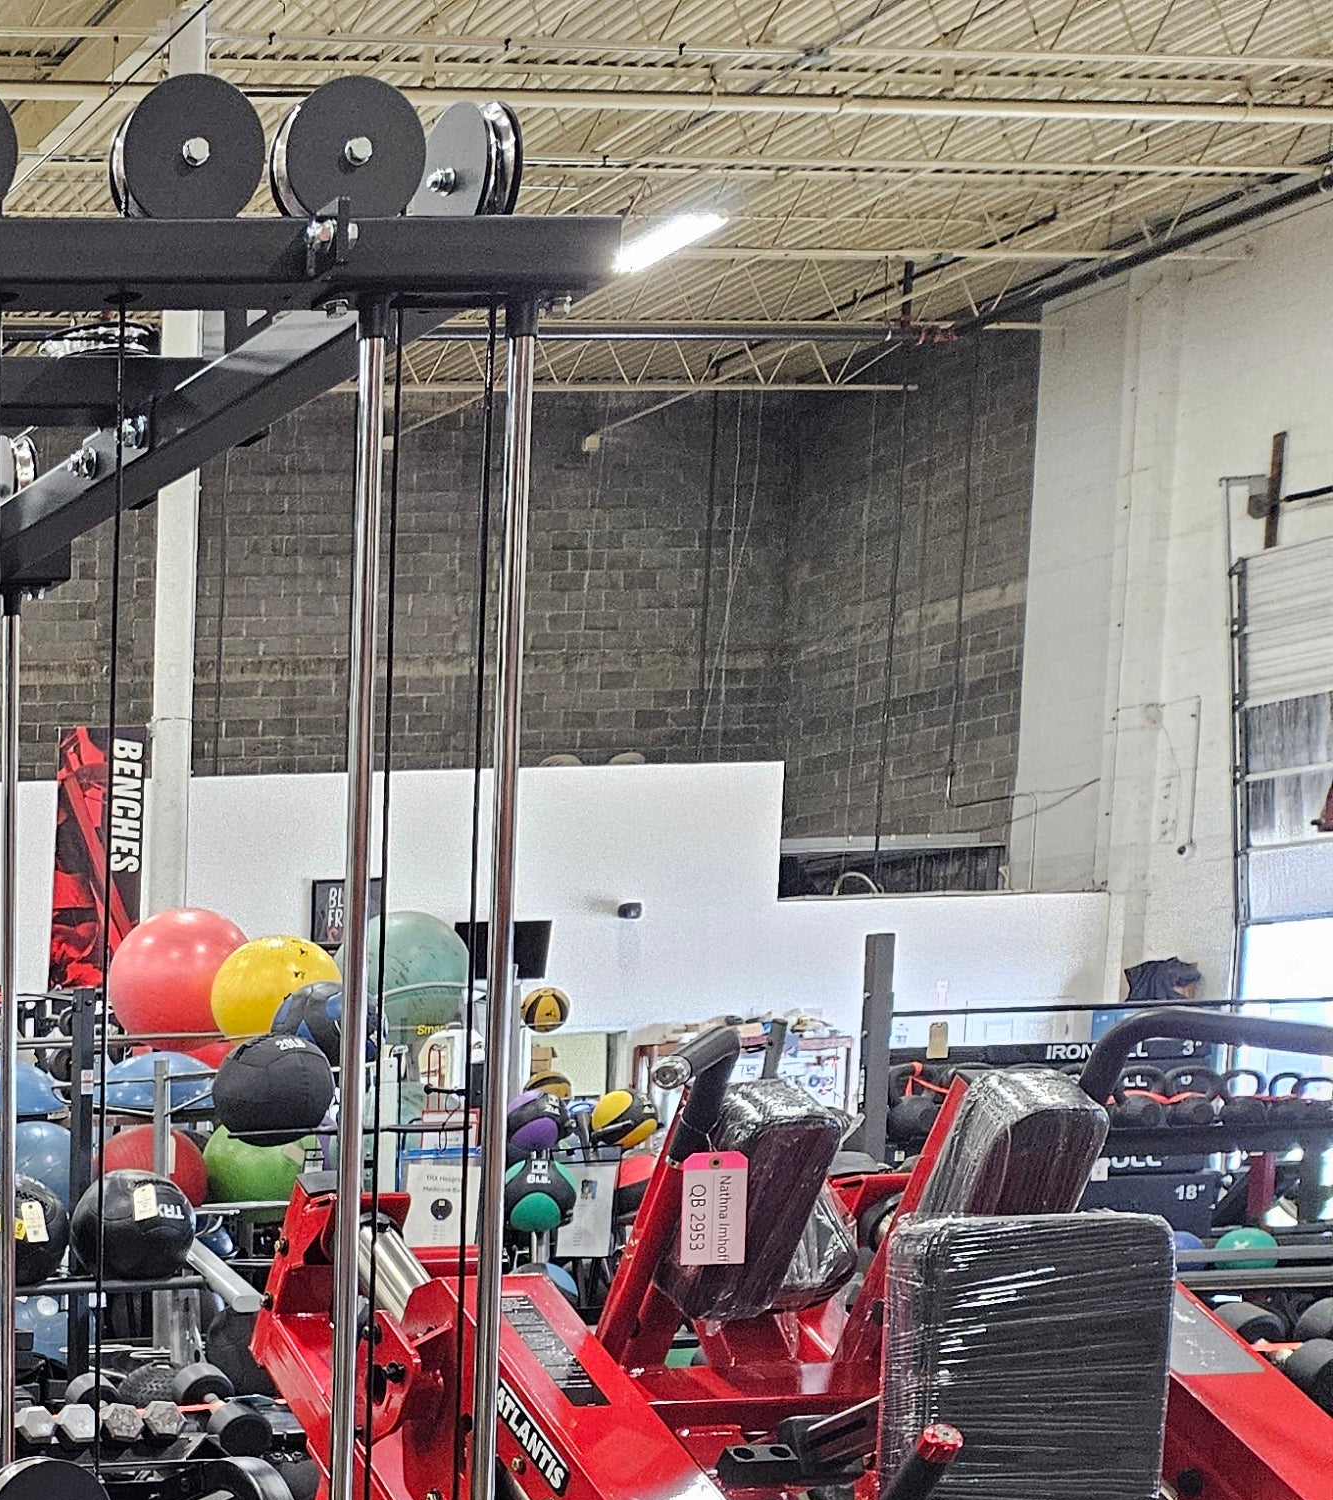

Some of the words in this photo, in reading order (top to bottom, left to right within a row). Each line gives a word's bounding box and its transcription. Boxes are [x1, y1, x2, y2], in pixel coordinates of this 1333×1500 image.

[109, 738, 144, 873] BENCHES
[689, 1184, 707, 1208] QB
[719, 1175, 732, 1219] Nathna
[689, 1213, 706, 1251] 2953
[717, 1223, 730, 1265] Imhoff
[497, 1386, 565, 1489] ATLANTIS
